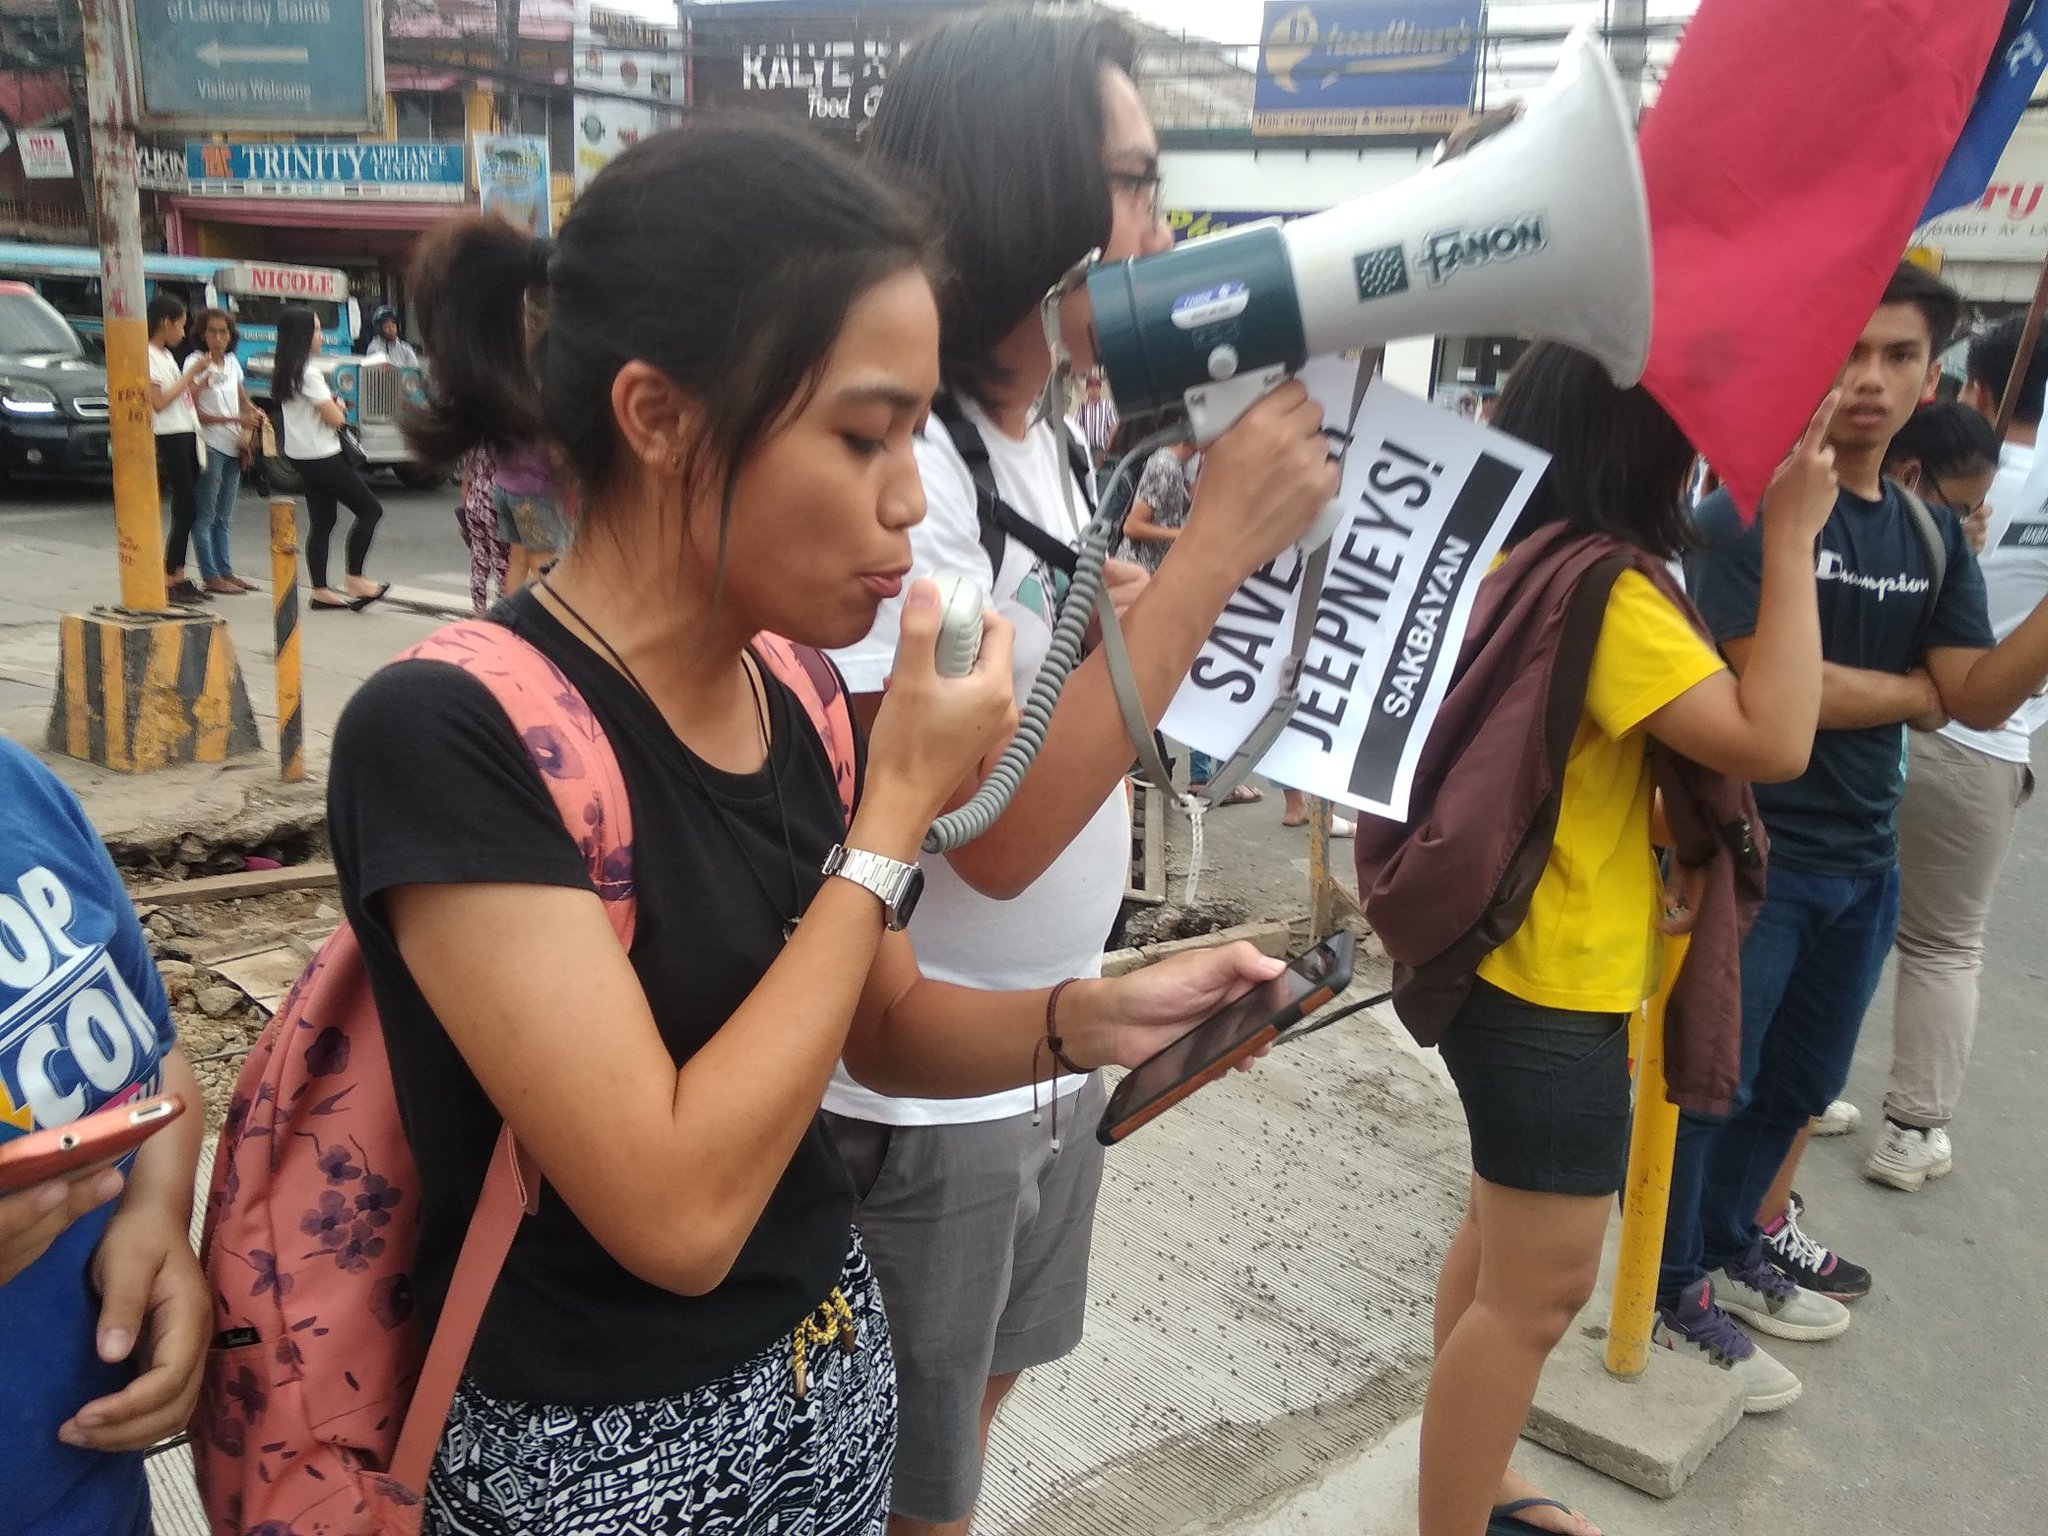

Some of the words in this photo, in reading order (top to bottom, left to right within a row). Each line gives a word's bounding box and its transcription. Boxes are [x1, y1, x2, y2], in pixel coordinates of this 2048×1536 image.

[743, 41, 854, 90] KALYE
[242, 145, 367, 180] TRINITY
[370, 145, 448, 166] APPLIANCE
[374, 161, 430, 181] CENTER
[252, 268, 335, 295] NICOLE
[1285, 438, 1446, 754] JEEPNEYS!
[1815, 549, 1929, 601] Champion
[1383, 534, 1471, 719] SAKBAYAN
